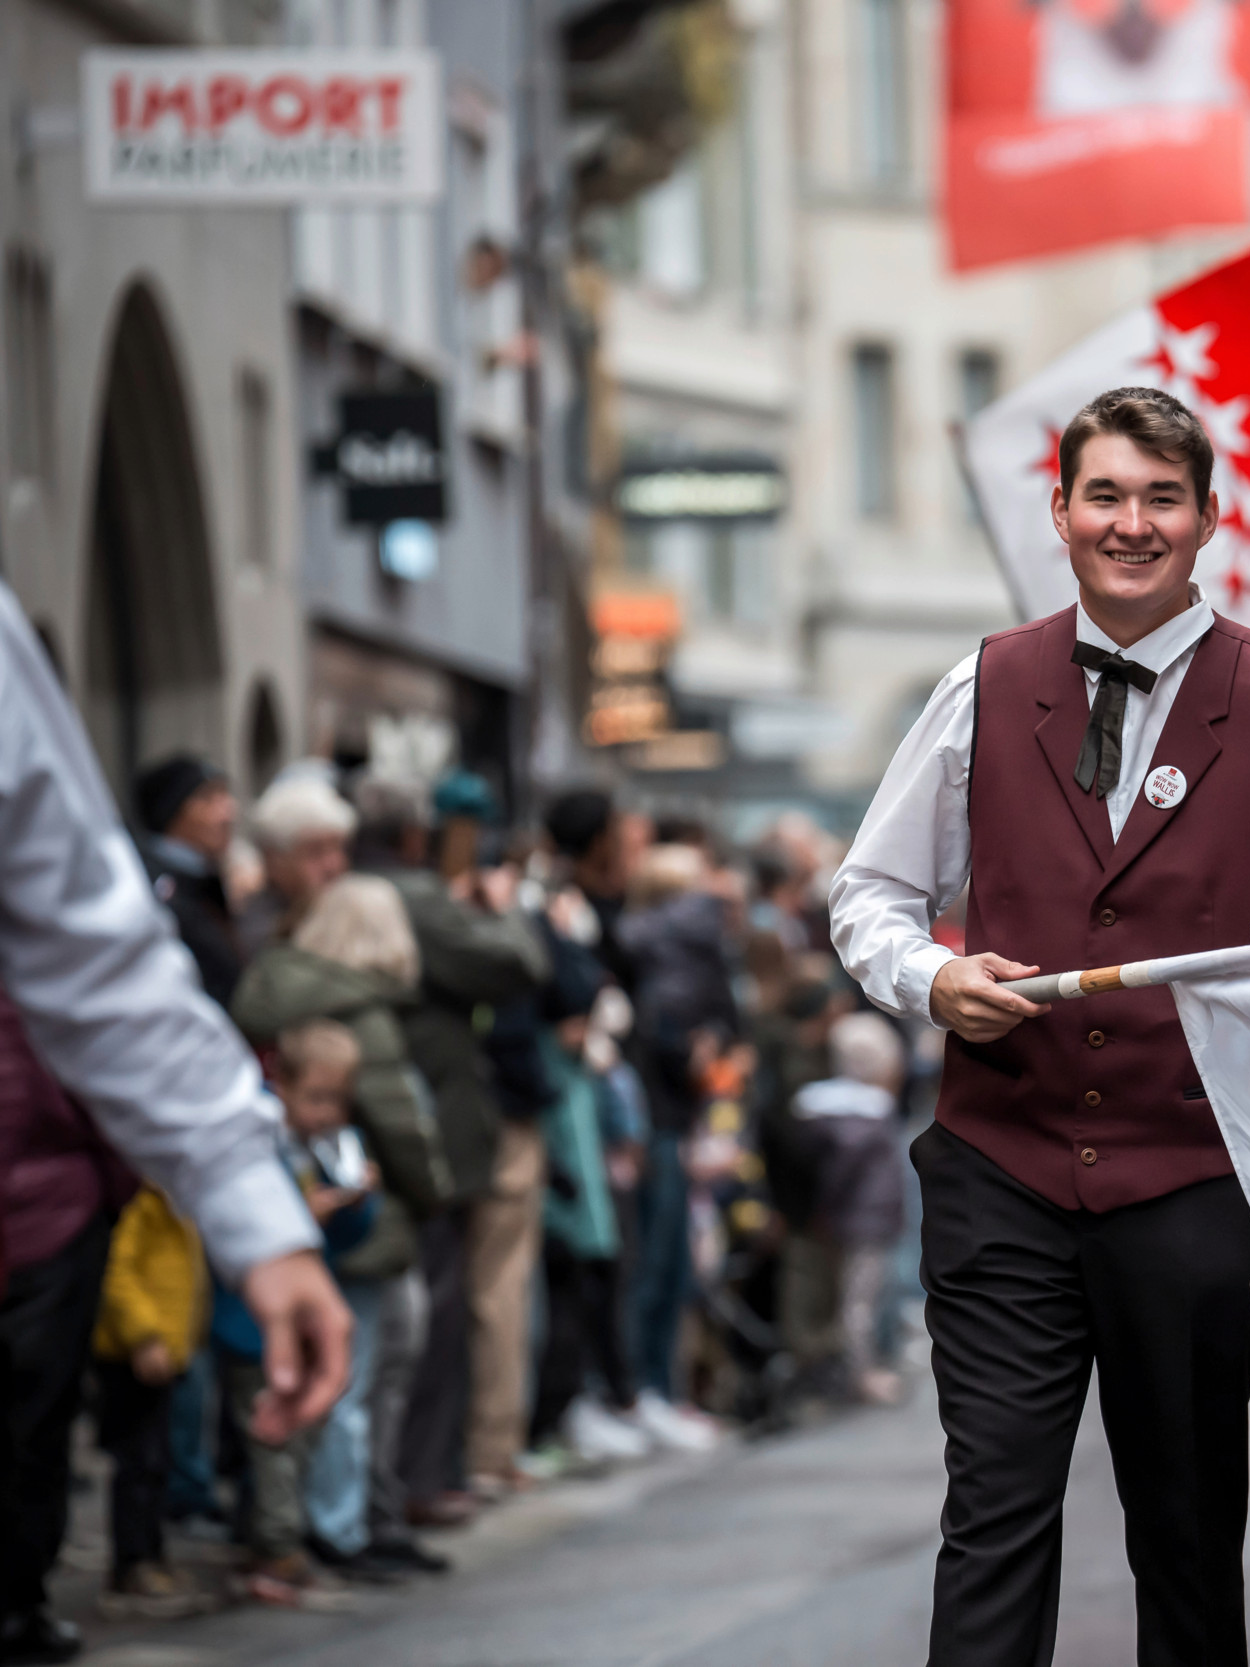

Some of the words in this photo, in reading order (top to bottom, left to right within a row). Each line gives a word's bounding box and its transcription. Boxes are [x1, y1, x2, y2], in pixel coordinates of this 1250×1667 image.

[111, 71, 407, 138] IMPORT
[1155, 774, 1168, 783] WOW
[1167, 780, 1179, 790] WOW
